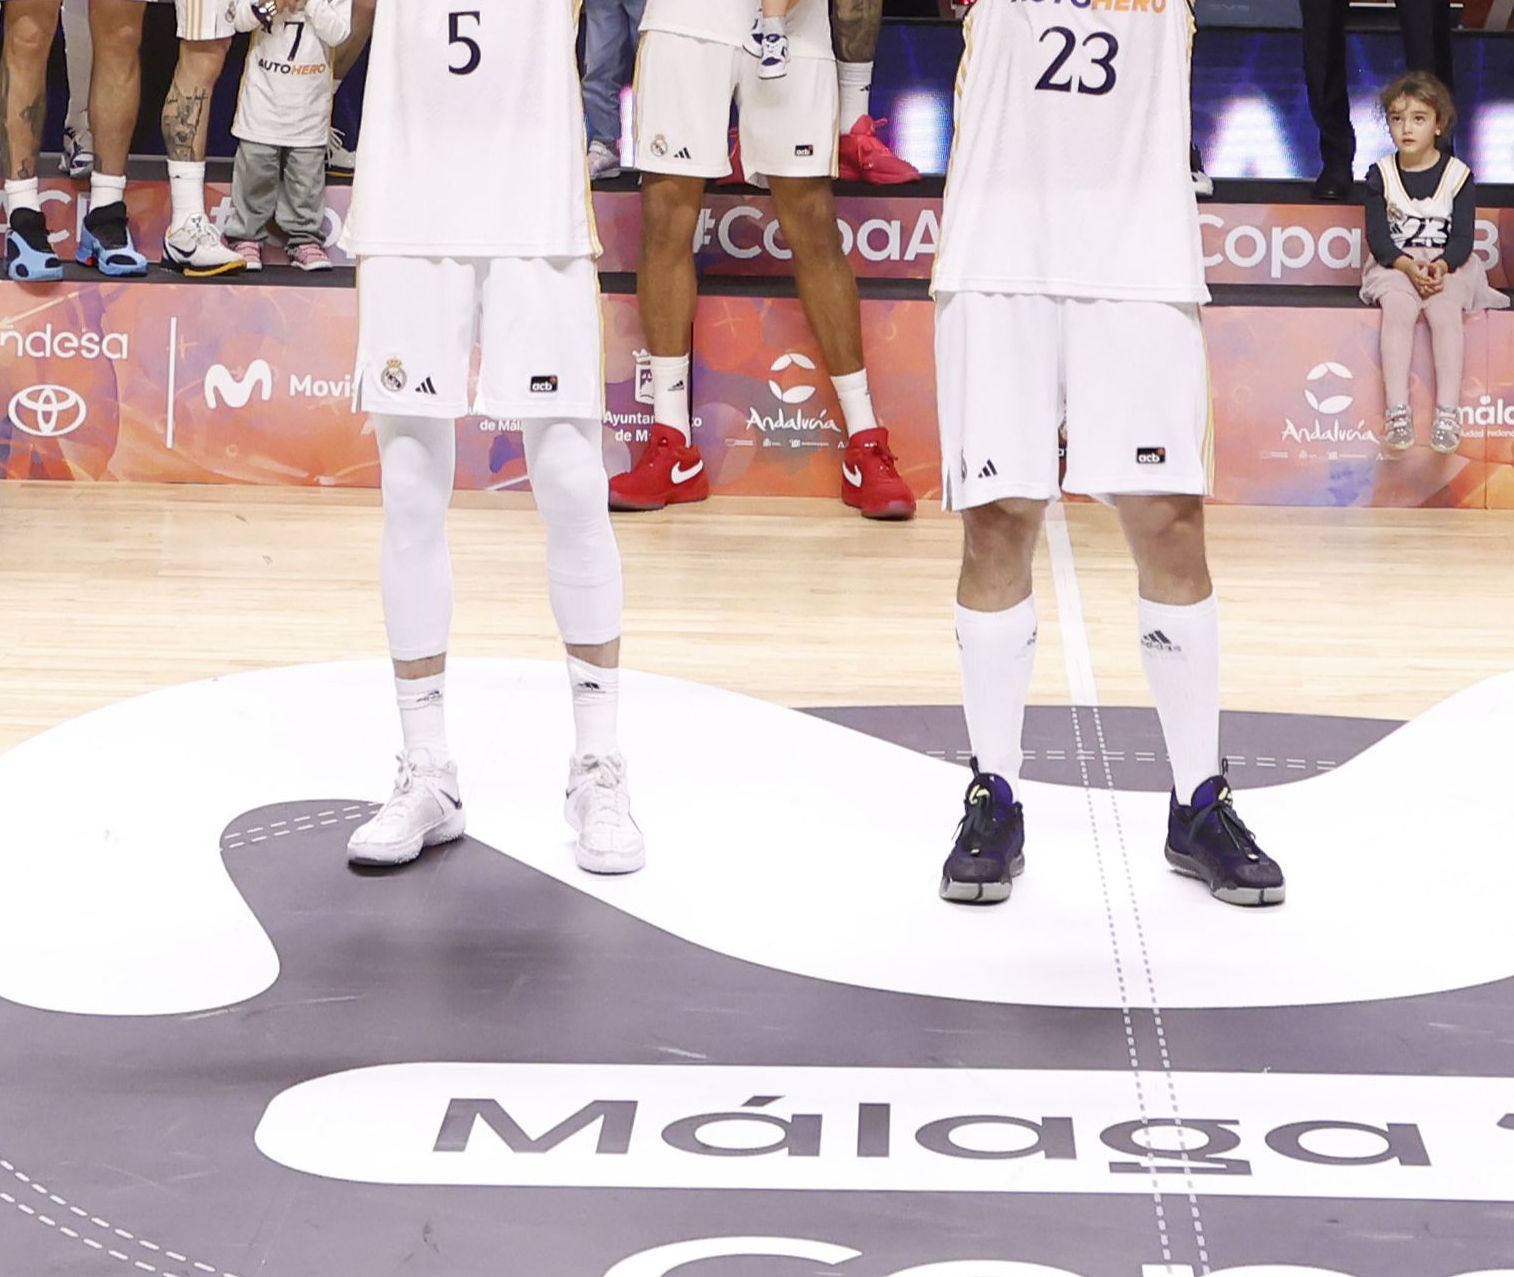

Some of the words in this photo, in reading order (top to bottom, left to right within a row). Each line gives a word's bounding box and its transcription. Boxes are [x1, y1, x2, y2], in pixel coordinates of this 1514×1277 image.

[283, 22, 305, 62] 7
[448, 10, 481, 76] 5
[258, 58, 326, 76] AUTOHERO
[1035, 25, 1120, 96] 23
[1403, 215, 1450, 248] 23
[290, 374, 359, 398] Movi
[532, 382, 553, 391] acb
[480, 419, 495, 431] de
[498, 418, 522, 431] Mál
[615, 430, 632, 442] de
[1138, 453, 1160, 462] acb
[432, 1095, 1432, 1176] Málaga
